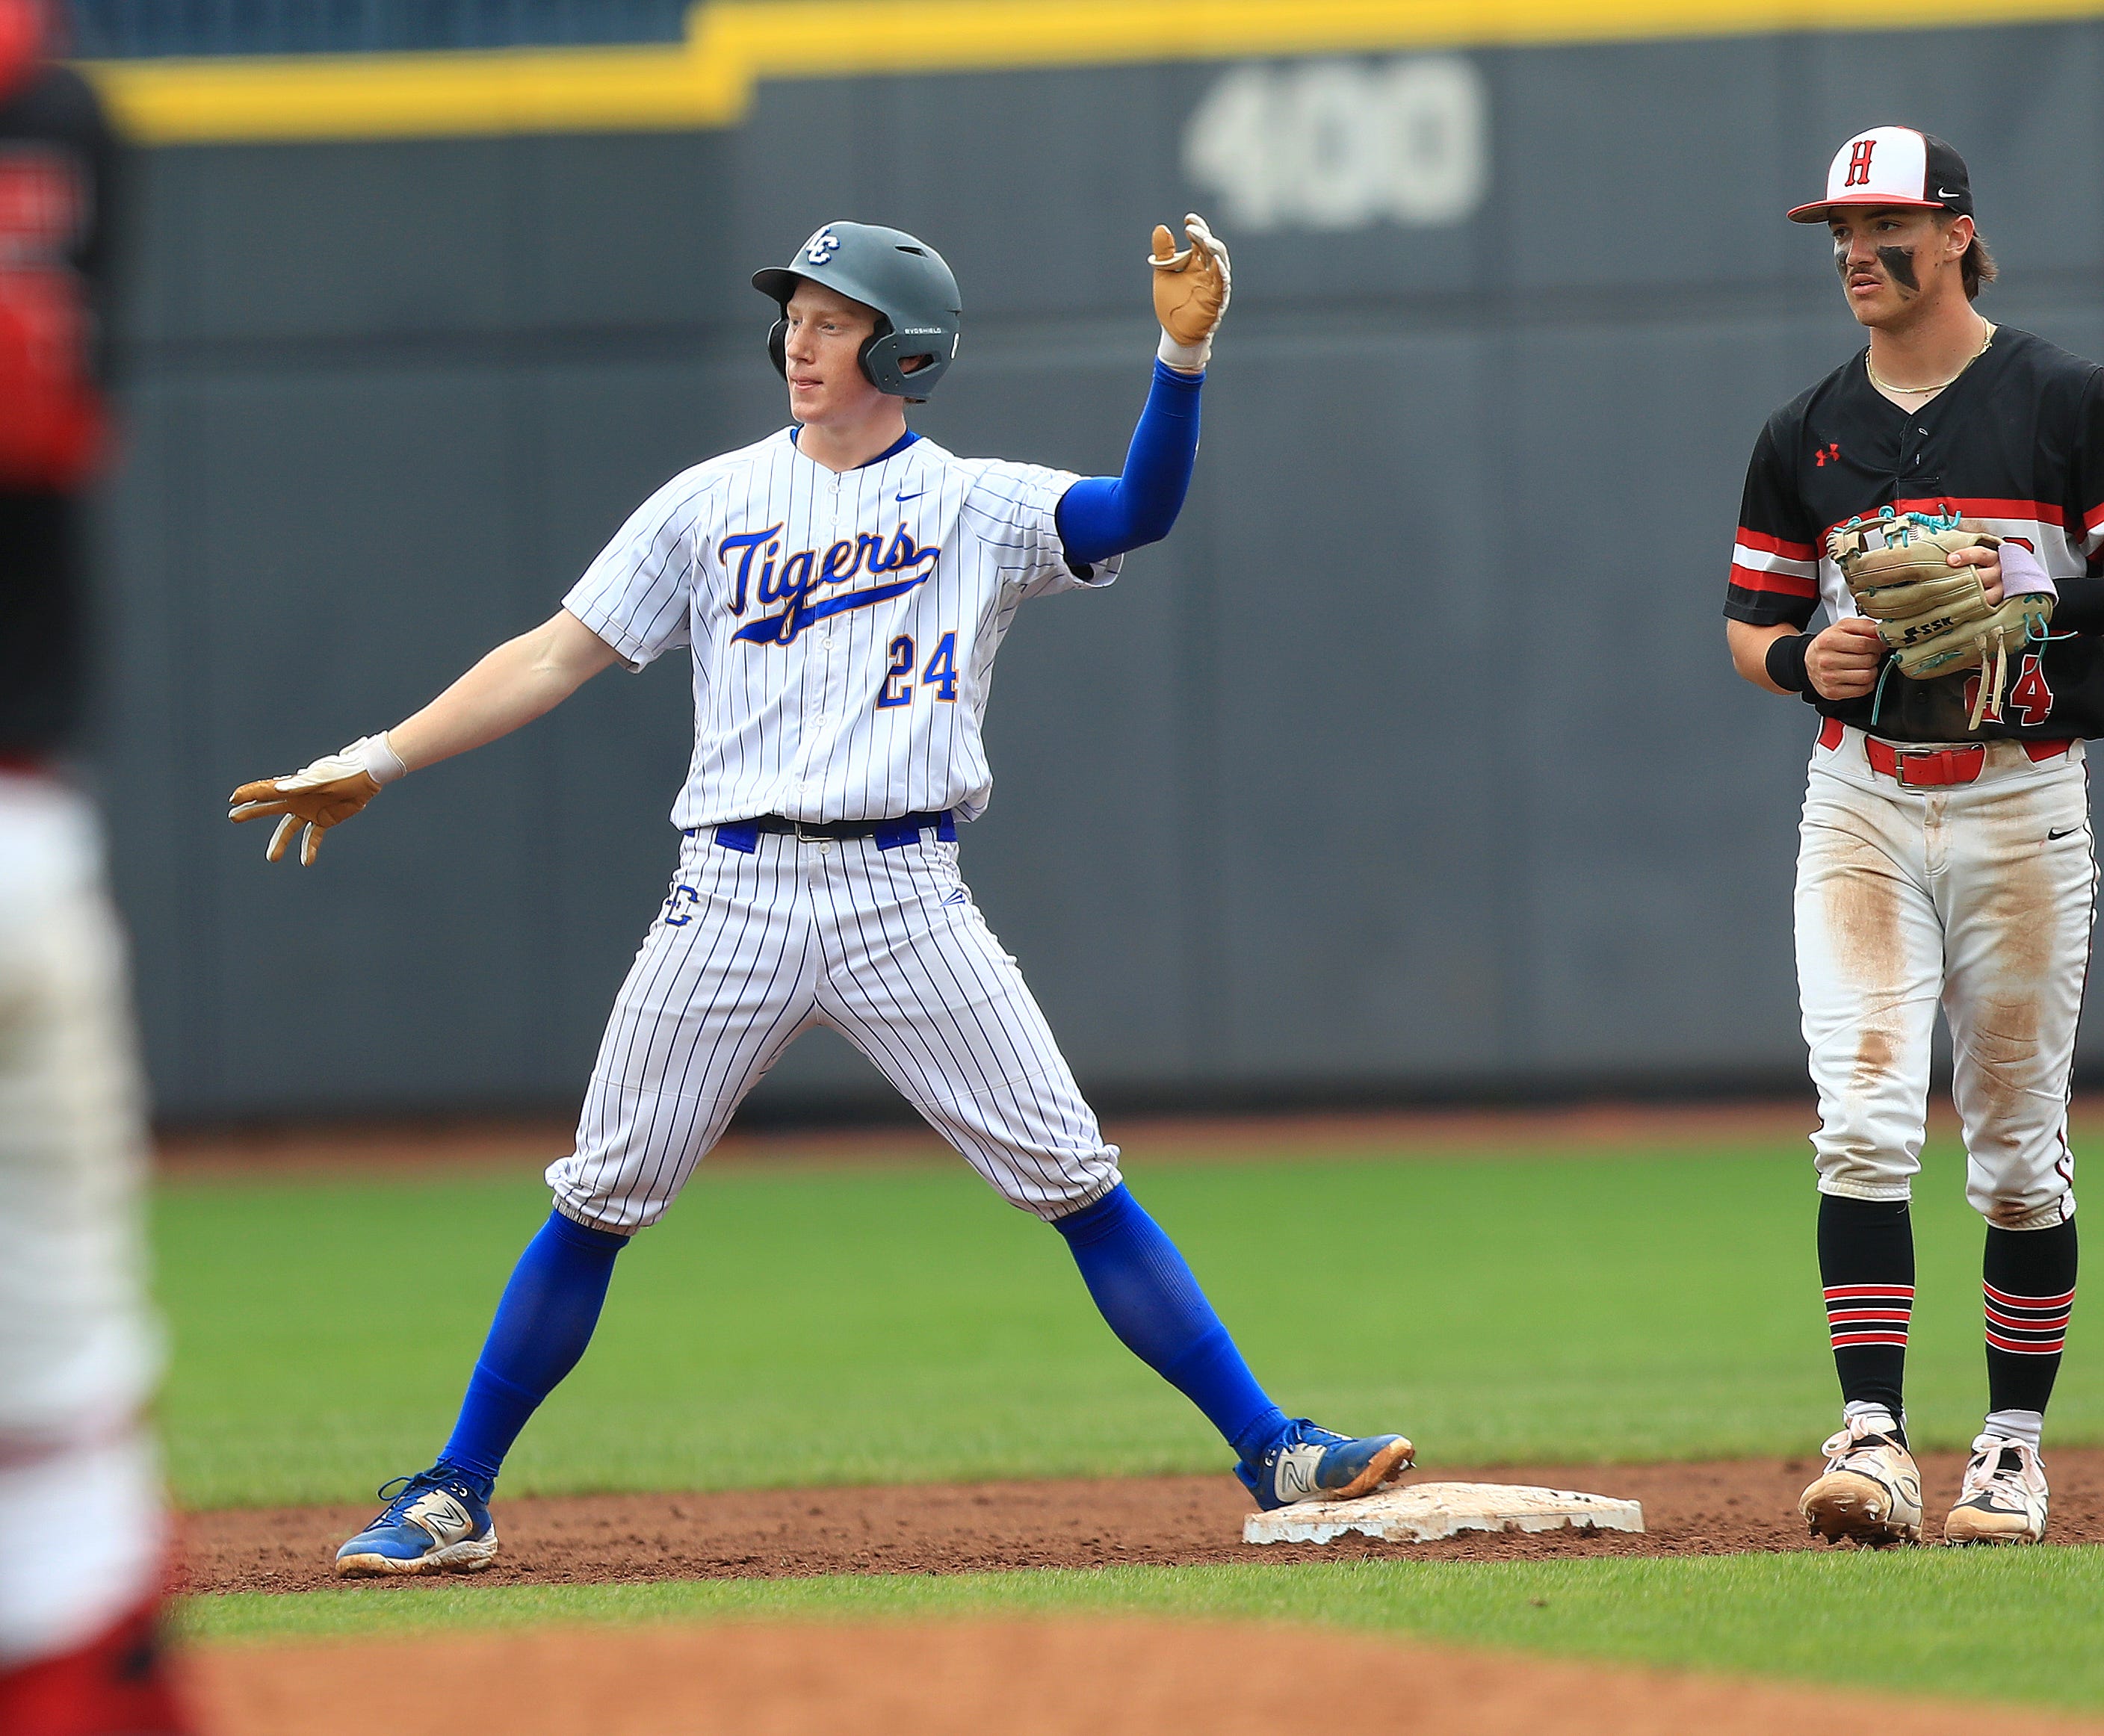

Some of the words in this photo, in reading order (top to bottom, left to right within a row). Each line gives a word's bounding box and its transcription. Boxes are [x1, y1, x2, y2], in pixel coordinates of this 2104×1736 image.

[1182, 58, 1487, 229] 400
[1845, 140, 1877, 187] H
[718, 521, 941, 648] Tigers
[1919, 616, 1955, 635] SSK
[876, 630, 959, 710] 24
